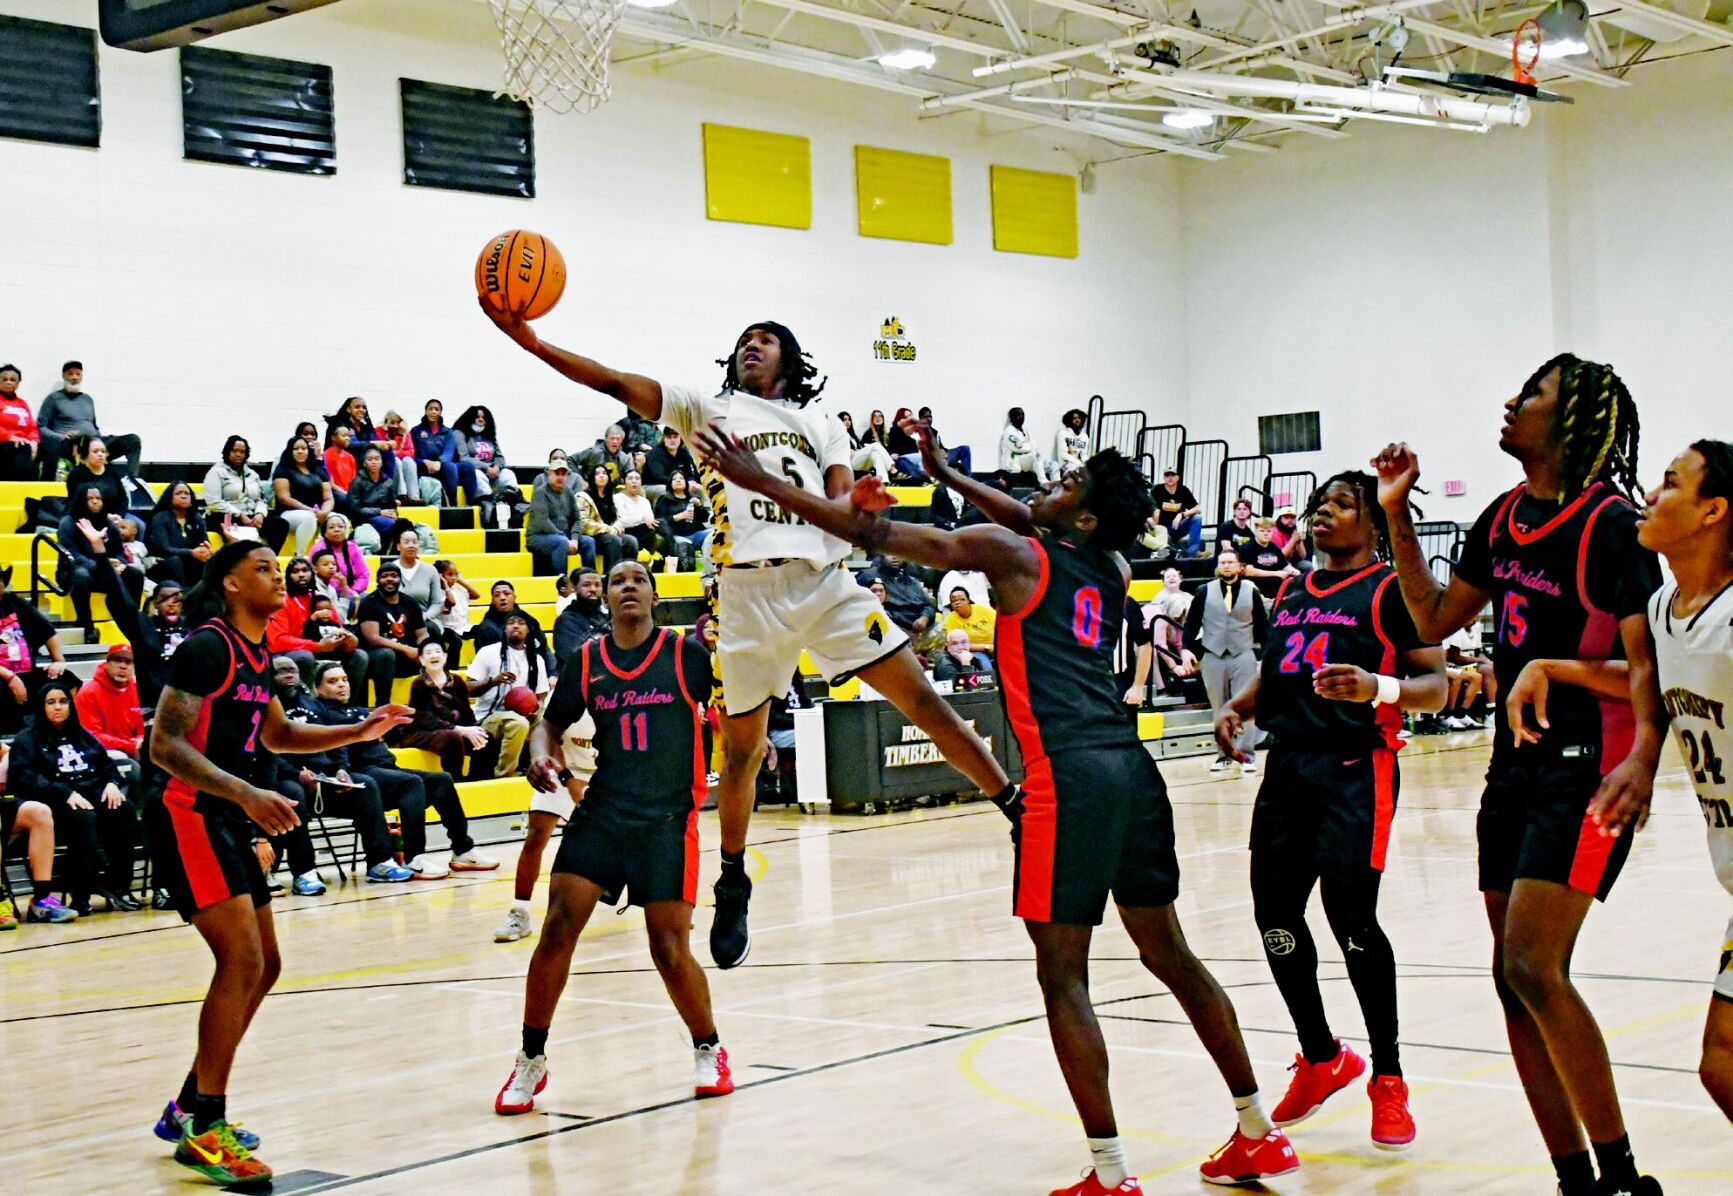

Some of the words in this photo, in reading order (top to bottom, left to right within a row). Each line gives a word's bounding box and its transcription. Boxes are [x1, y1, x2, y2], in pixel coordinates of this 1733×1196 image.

[892, 341, 917, 361] Grade
[1073, 586, 1103, 649] 0
[1273, 608, 1304, 627] Red
[1303, 607, 1358, 627] Raiders
[1280, 631, 1329, 674] 24
[594, 692, 619, 710] Red
[622, 688, 675, 707] Raiders
[620, 712, 648, 751] 11
[1681, 729, 1726, 784] 24
